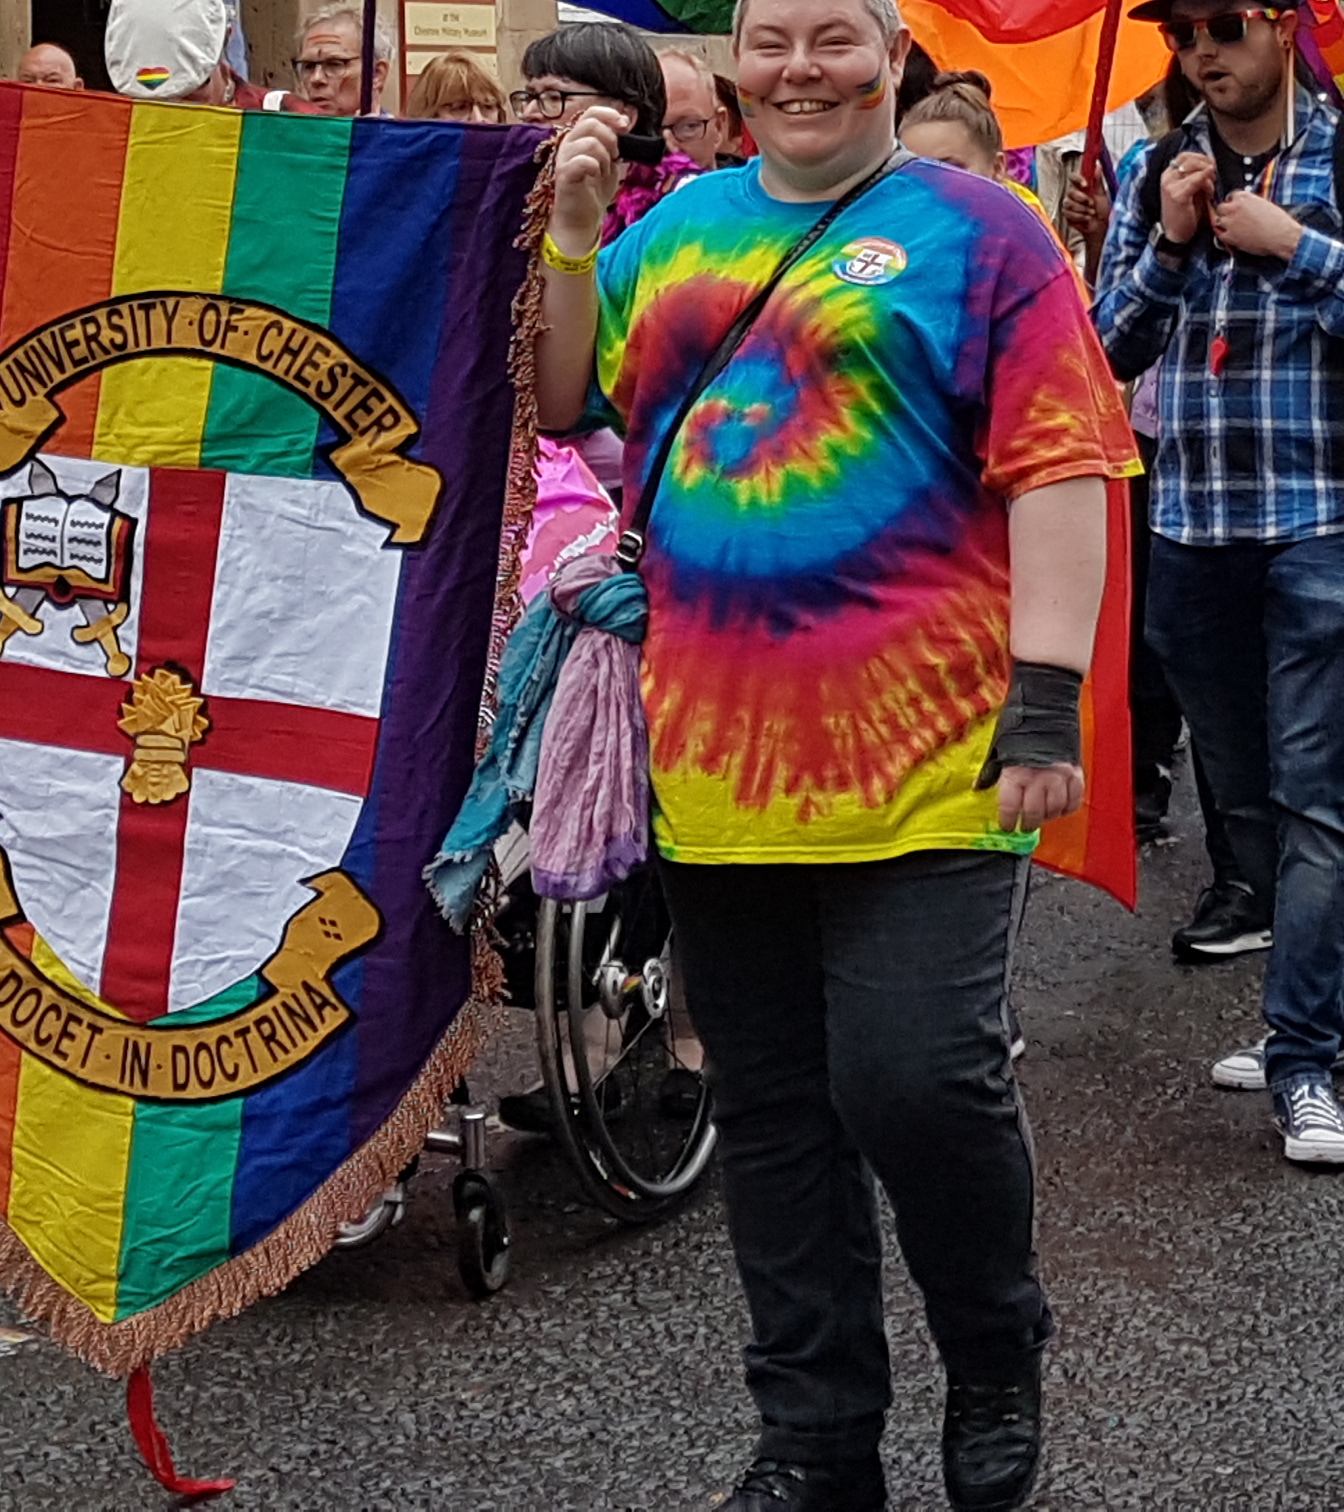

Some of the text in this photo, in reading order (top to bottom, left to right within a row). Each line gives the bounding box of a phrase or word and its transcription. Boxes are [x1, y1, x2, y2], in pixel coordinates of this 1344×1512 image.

[197, 301, 245, 348] OF
[256, 319, 401, 448] CHESTER
[118, 1037, 152, 1089] IN
[171, 980, 338, 1092] DOCTRINA
